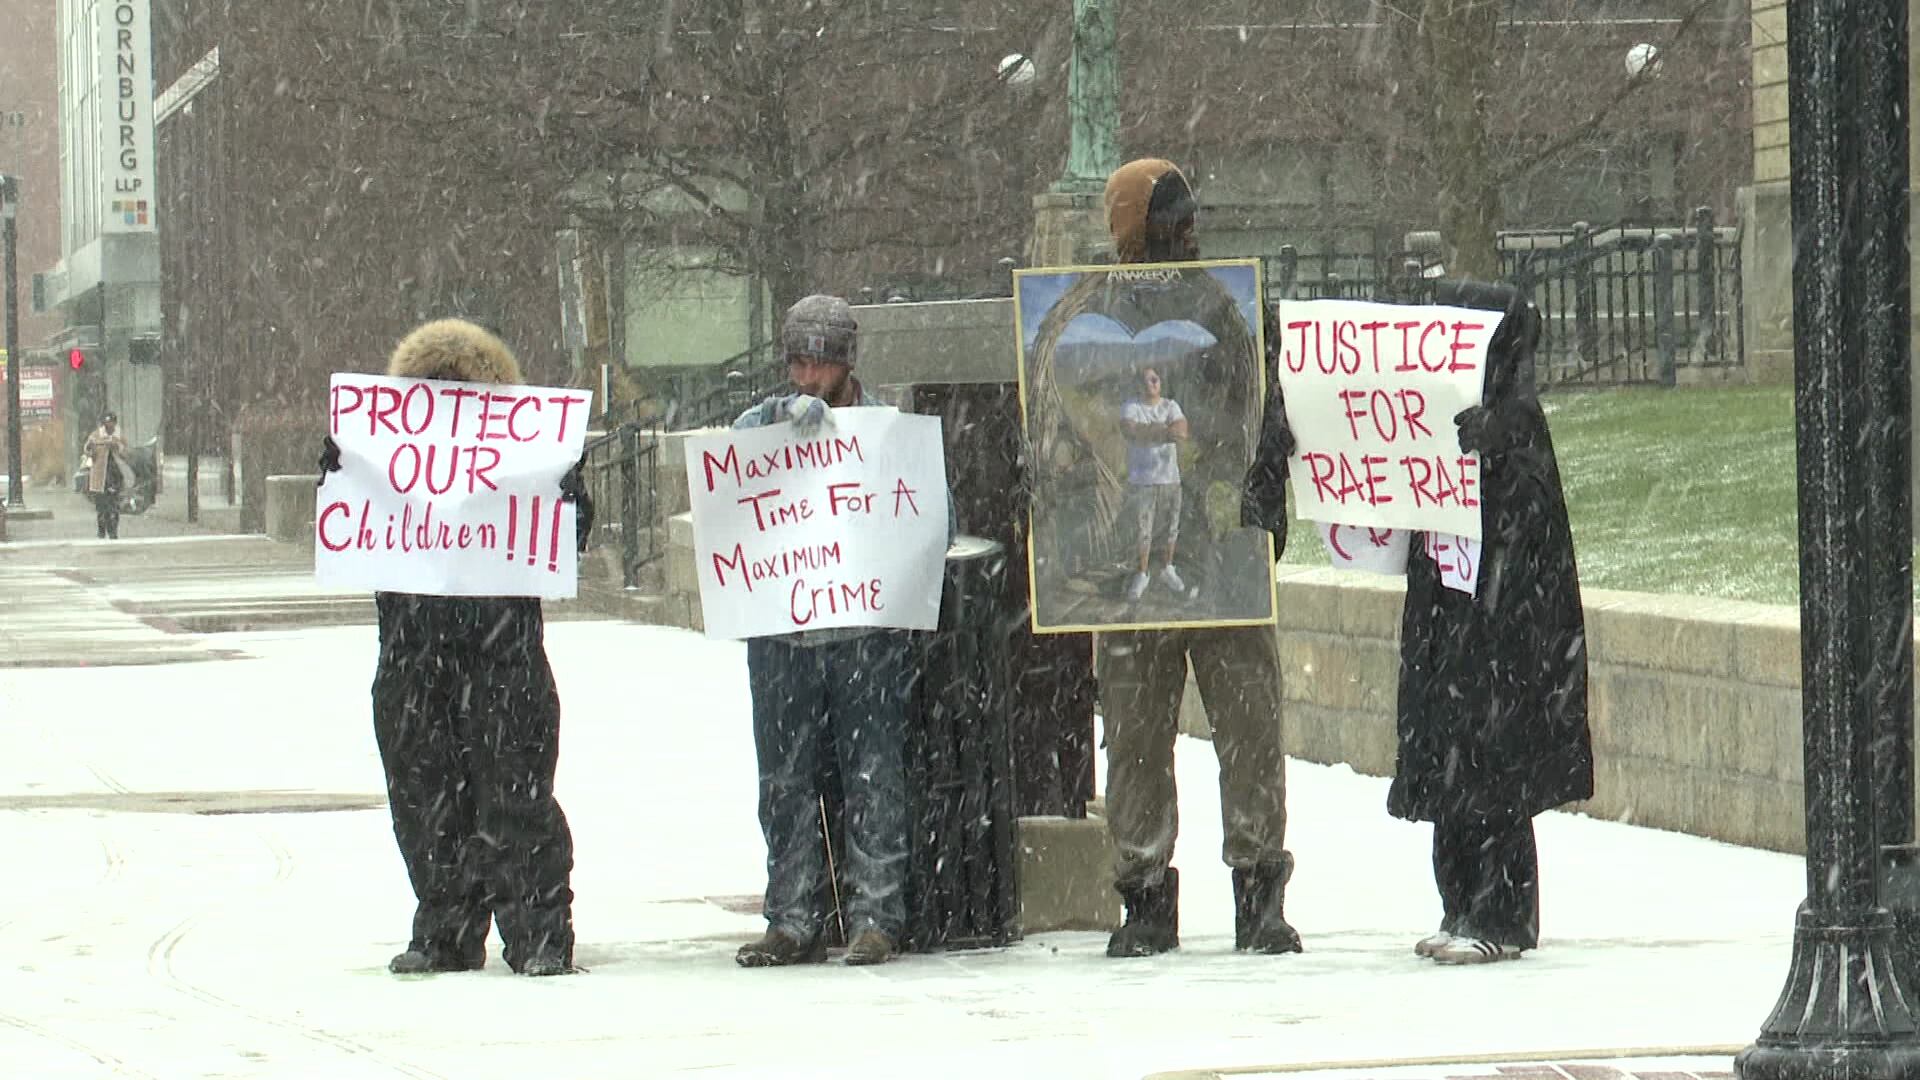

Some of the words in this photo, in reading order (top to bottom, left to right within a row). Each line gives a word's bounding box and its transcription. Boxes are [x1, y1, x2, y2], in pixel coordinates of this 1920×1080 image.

[115, 0, 136, 170] ORNBURG
[115, 178, 142, 192] LLP
[1286, 320, 1484, 375] JUSTICE
[332, 383, 585, 442] PROTECT
[1339, 389, 1433, 442] FOR
[388, 443, 501, 495] OUR
[1301, 452, 1393, 507] RAE
[1399, 455, 1479, 508] RAE
[892, 478, 919, 518] A
[319, 495, 566, 572] Children!!!
